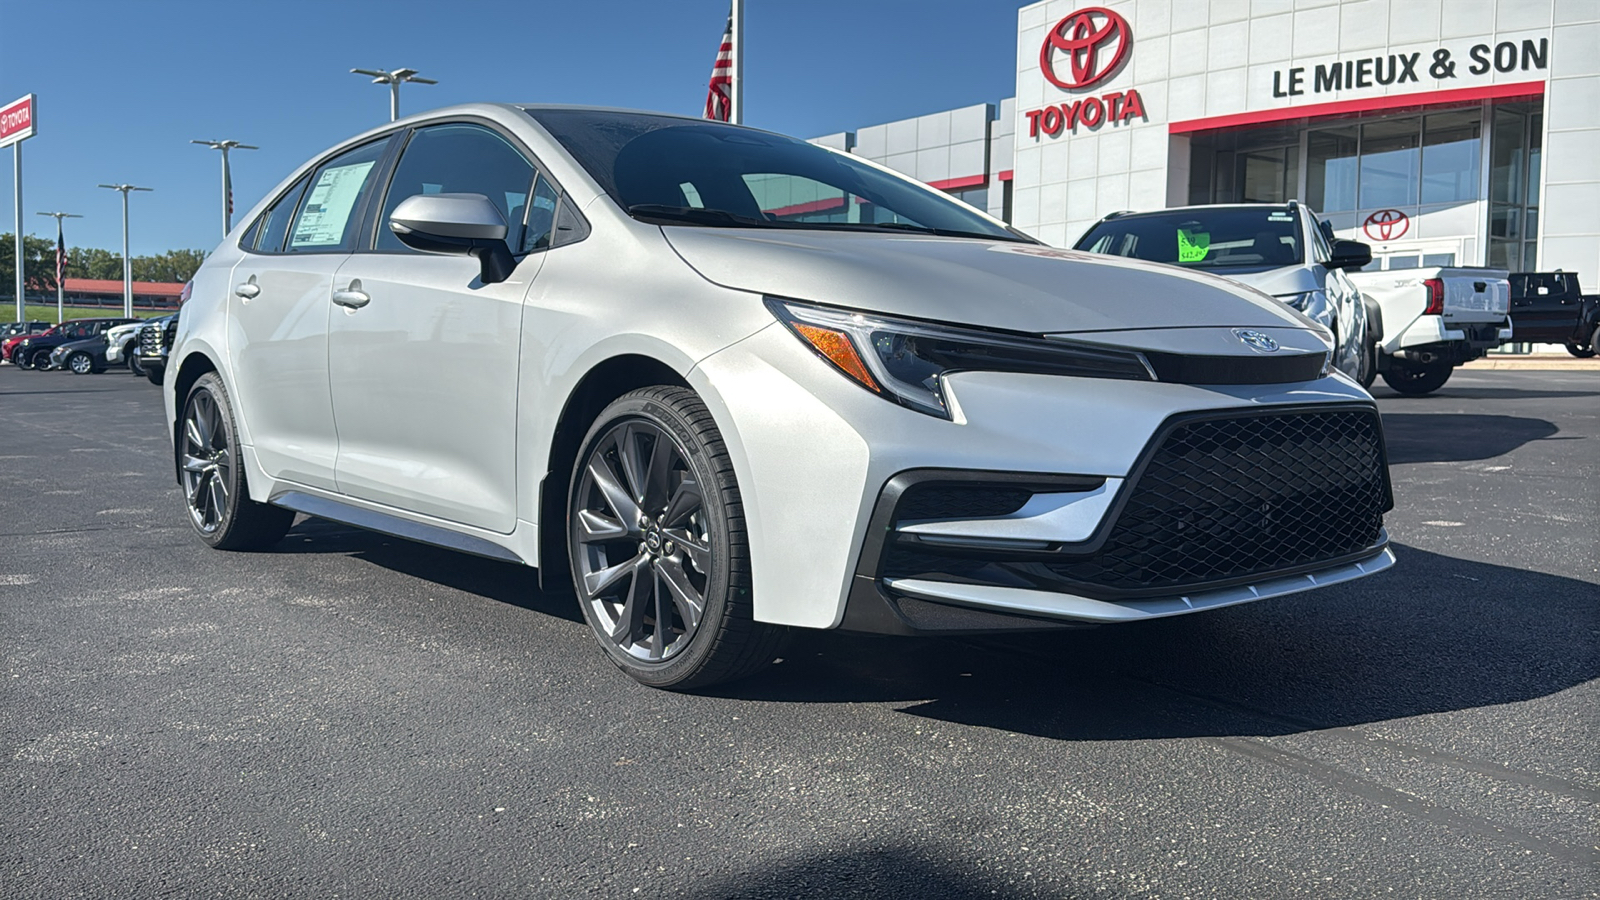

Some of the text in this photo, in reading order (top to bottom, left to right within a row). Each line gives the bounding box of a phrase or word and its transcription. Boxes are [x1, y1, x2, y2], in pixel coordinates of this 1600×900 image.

[1273, 37, 1548, 98] LE MIEUX & SON
[8, 106, 29, 129] TOYOTA
[1025, 89, 1145, 138] TOYOTA
[654, 408, 696, 450] DUNLOP
